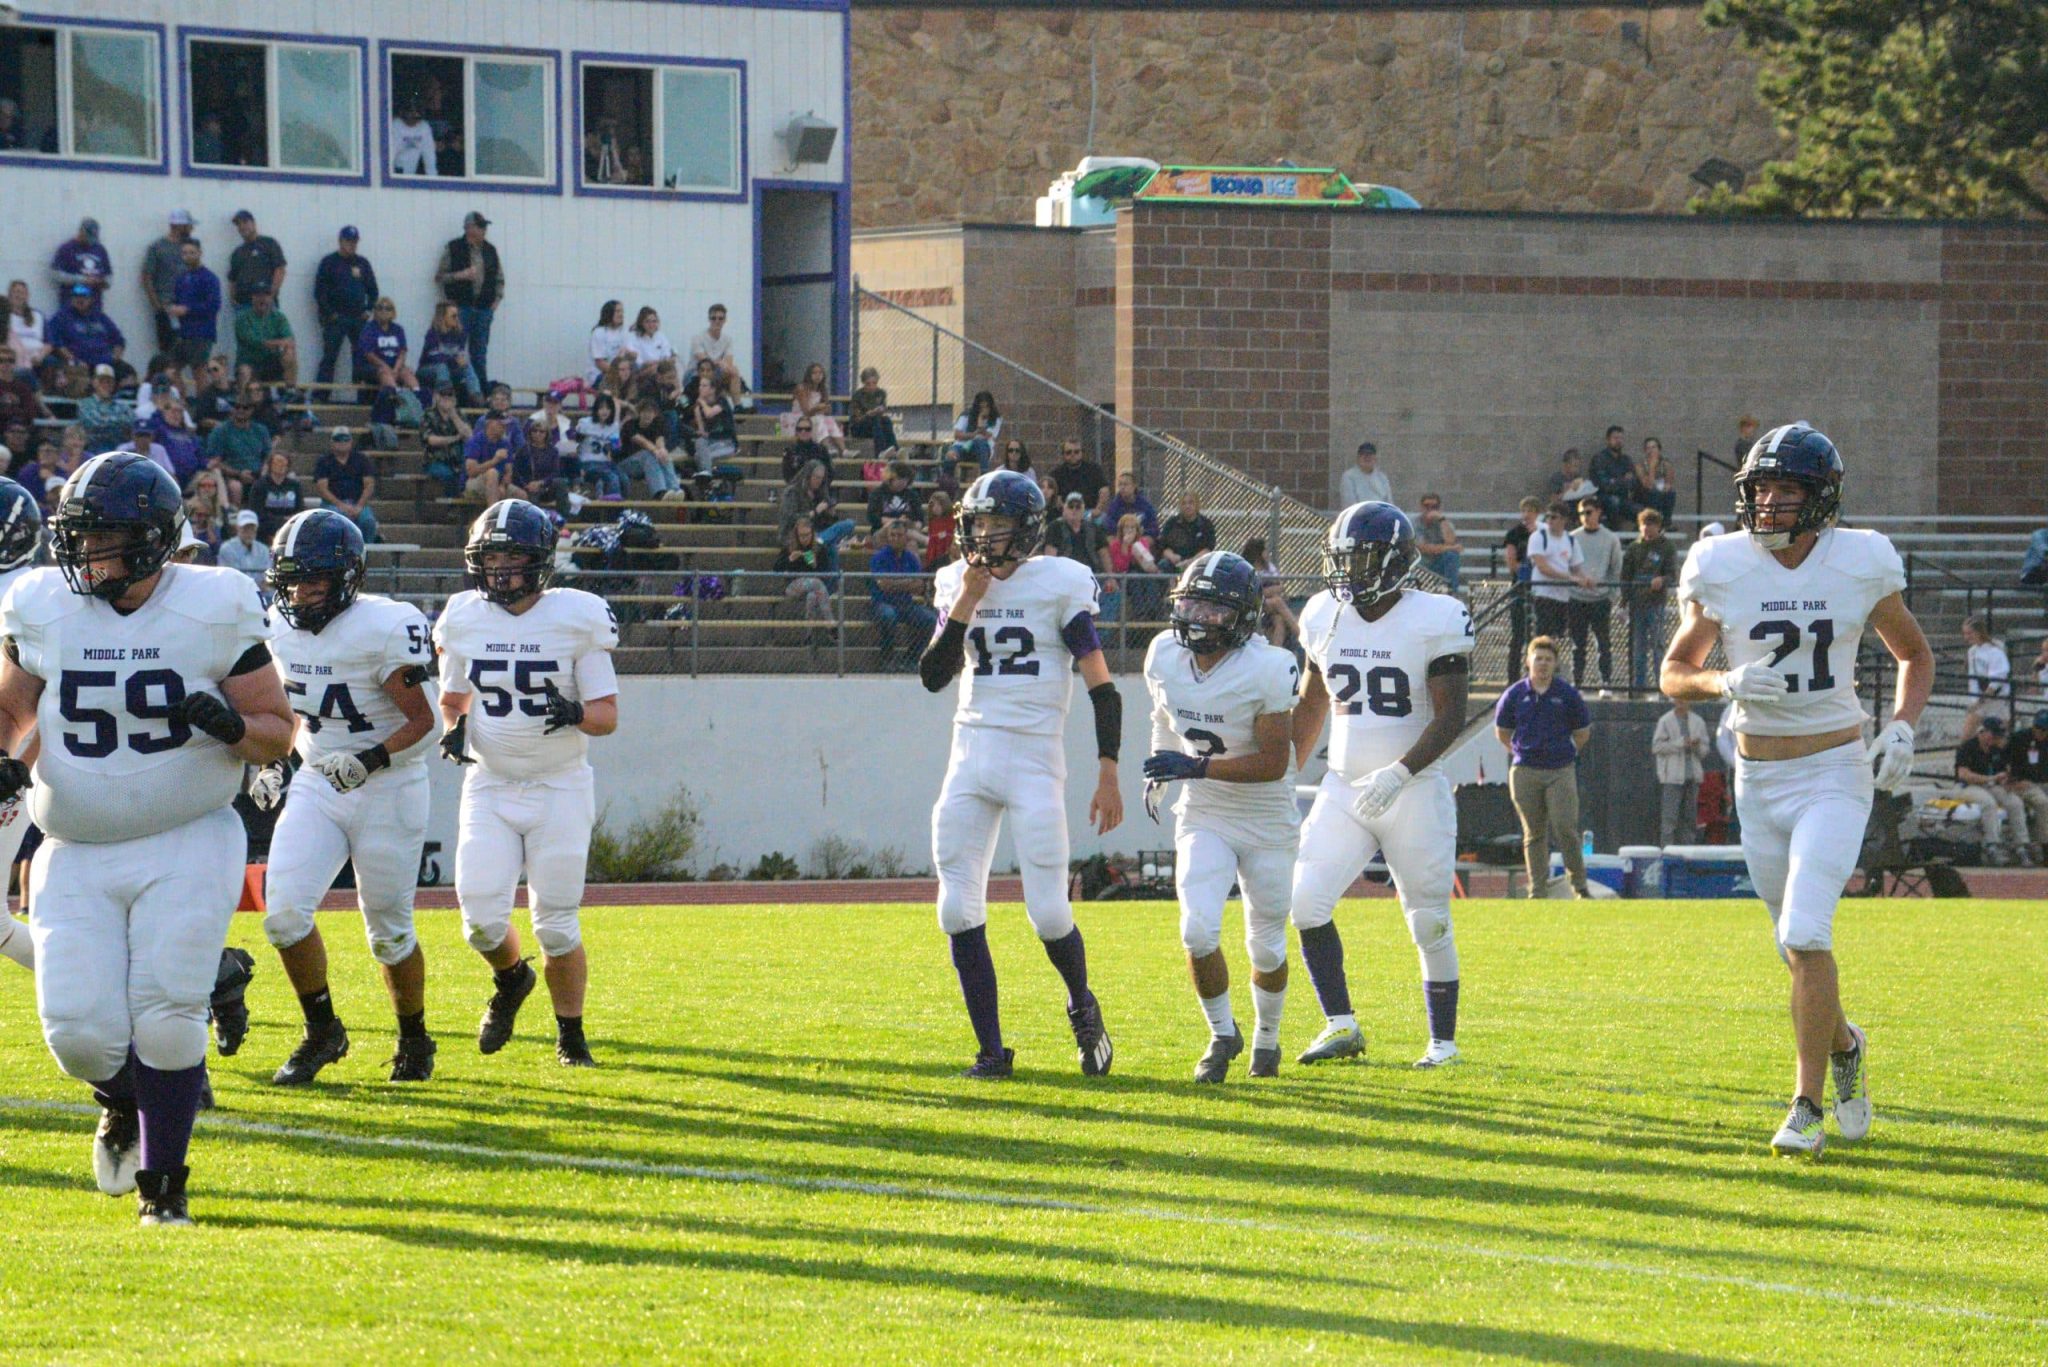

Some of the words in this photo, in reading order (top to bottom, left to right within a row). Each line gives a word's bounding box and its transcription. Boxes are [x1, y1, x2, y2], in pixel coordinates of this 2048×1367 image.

[1210, 175, 1264, 195] KONA
[1265, 176, 1298, 196] ICE
[976, 608, 1003, 619] MIDDLE
[1006, 609, 1025, 619] PARK
[1761, 600, 1797, 612] MIDDLE
[1803, 600, 1827, 611] PARK
[83, 648, 126, 661] MIDDLE
[131, 648, 160, 660] PARK
[485, 643, 516, 653] MIDDLE
[520, 644, 541, 653] PARK
[968, 626, 1040, 676] 12
[1340, 648, 1369, 659] MIDDLE
[1372, 649, 1392, 660] PARK
[1749, 619, 1835, 693] 21
[290, 662, 313, 676] MIDDLE
[315, 665, 333, 676] PARK
[469, 659, 560, 717] 55
[1327, 663, 1412, 718] 28
[60, 668, 193, 758] 59
[284, 678, 375, 734] 54
[1177, 708, 1202, 722] MIDDLE
[1204, 714, 1225, 724] PARK
